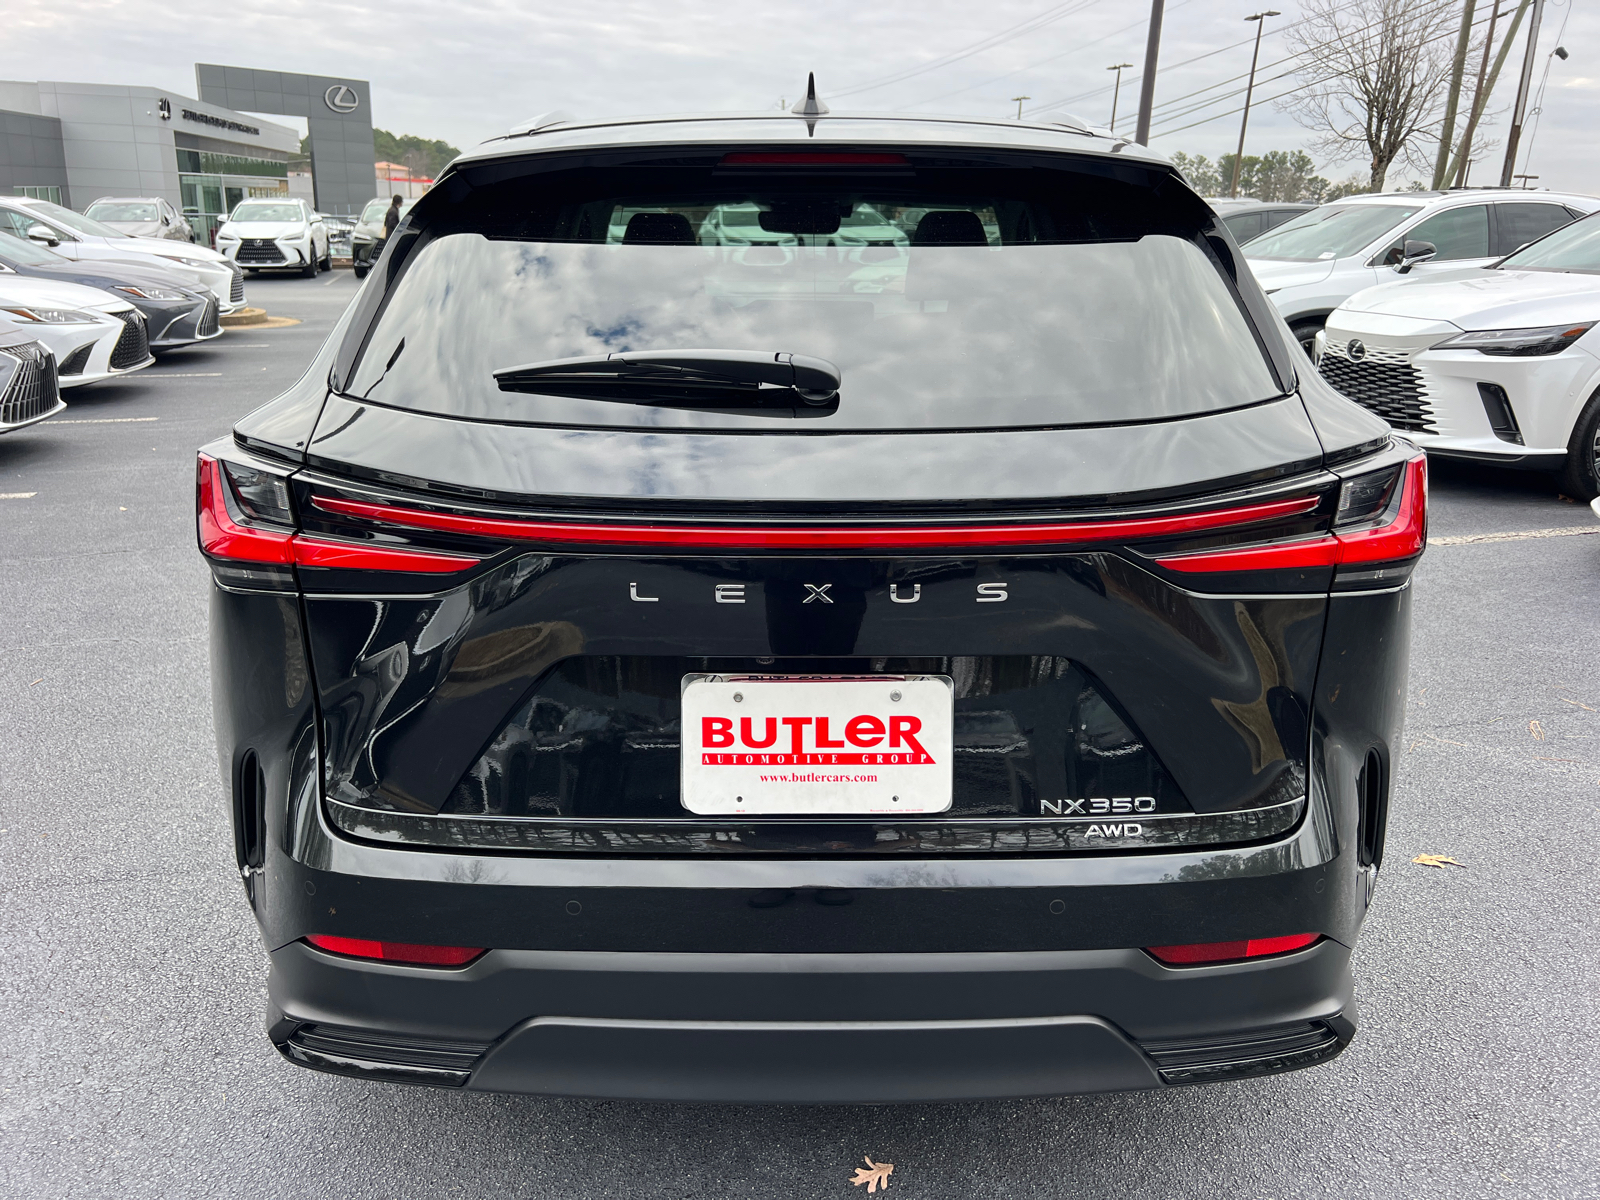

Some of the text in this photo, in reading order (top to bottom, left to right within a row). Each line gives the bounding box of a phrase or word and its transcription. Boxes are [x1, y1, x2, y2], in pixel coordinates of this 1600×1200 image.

[629, 582, 1008, 604] LEXUS
[702, 753, 929, 764] AUTOMOTIVE GROUP
[759, 772, 878, 783] www.butlercars.com
[1083, 823, 1143, 838] AWD
